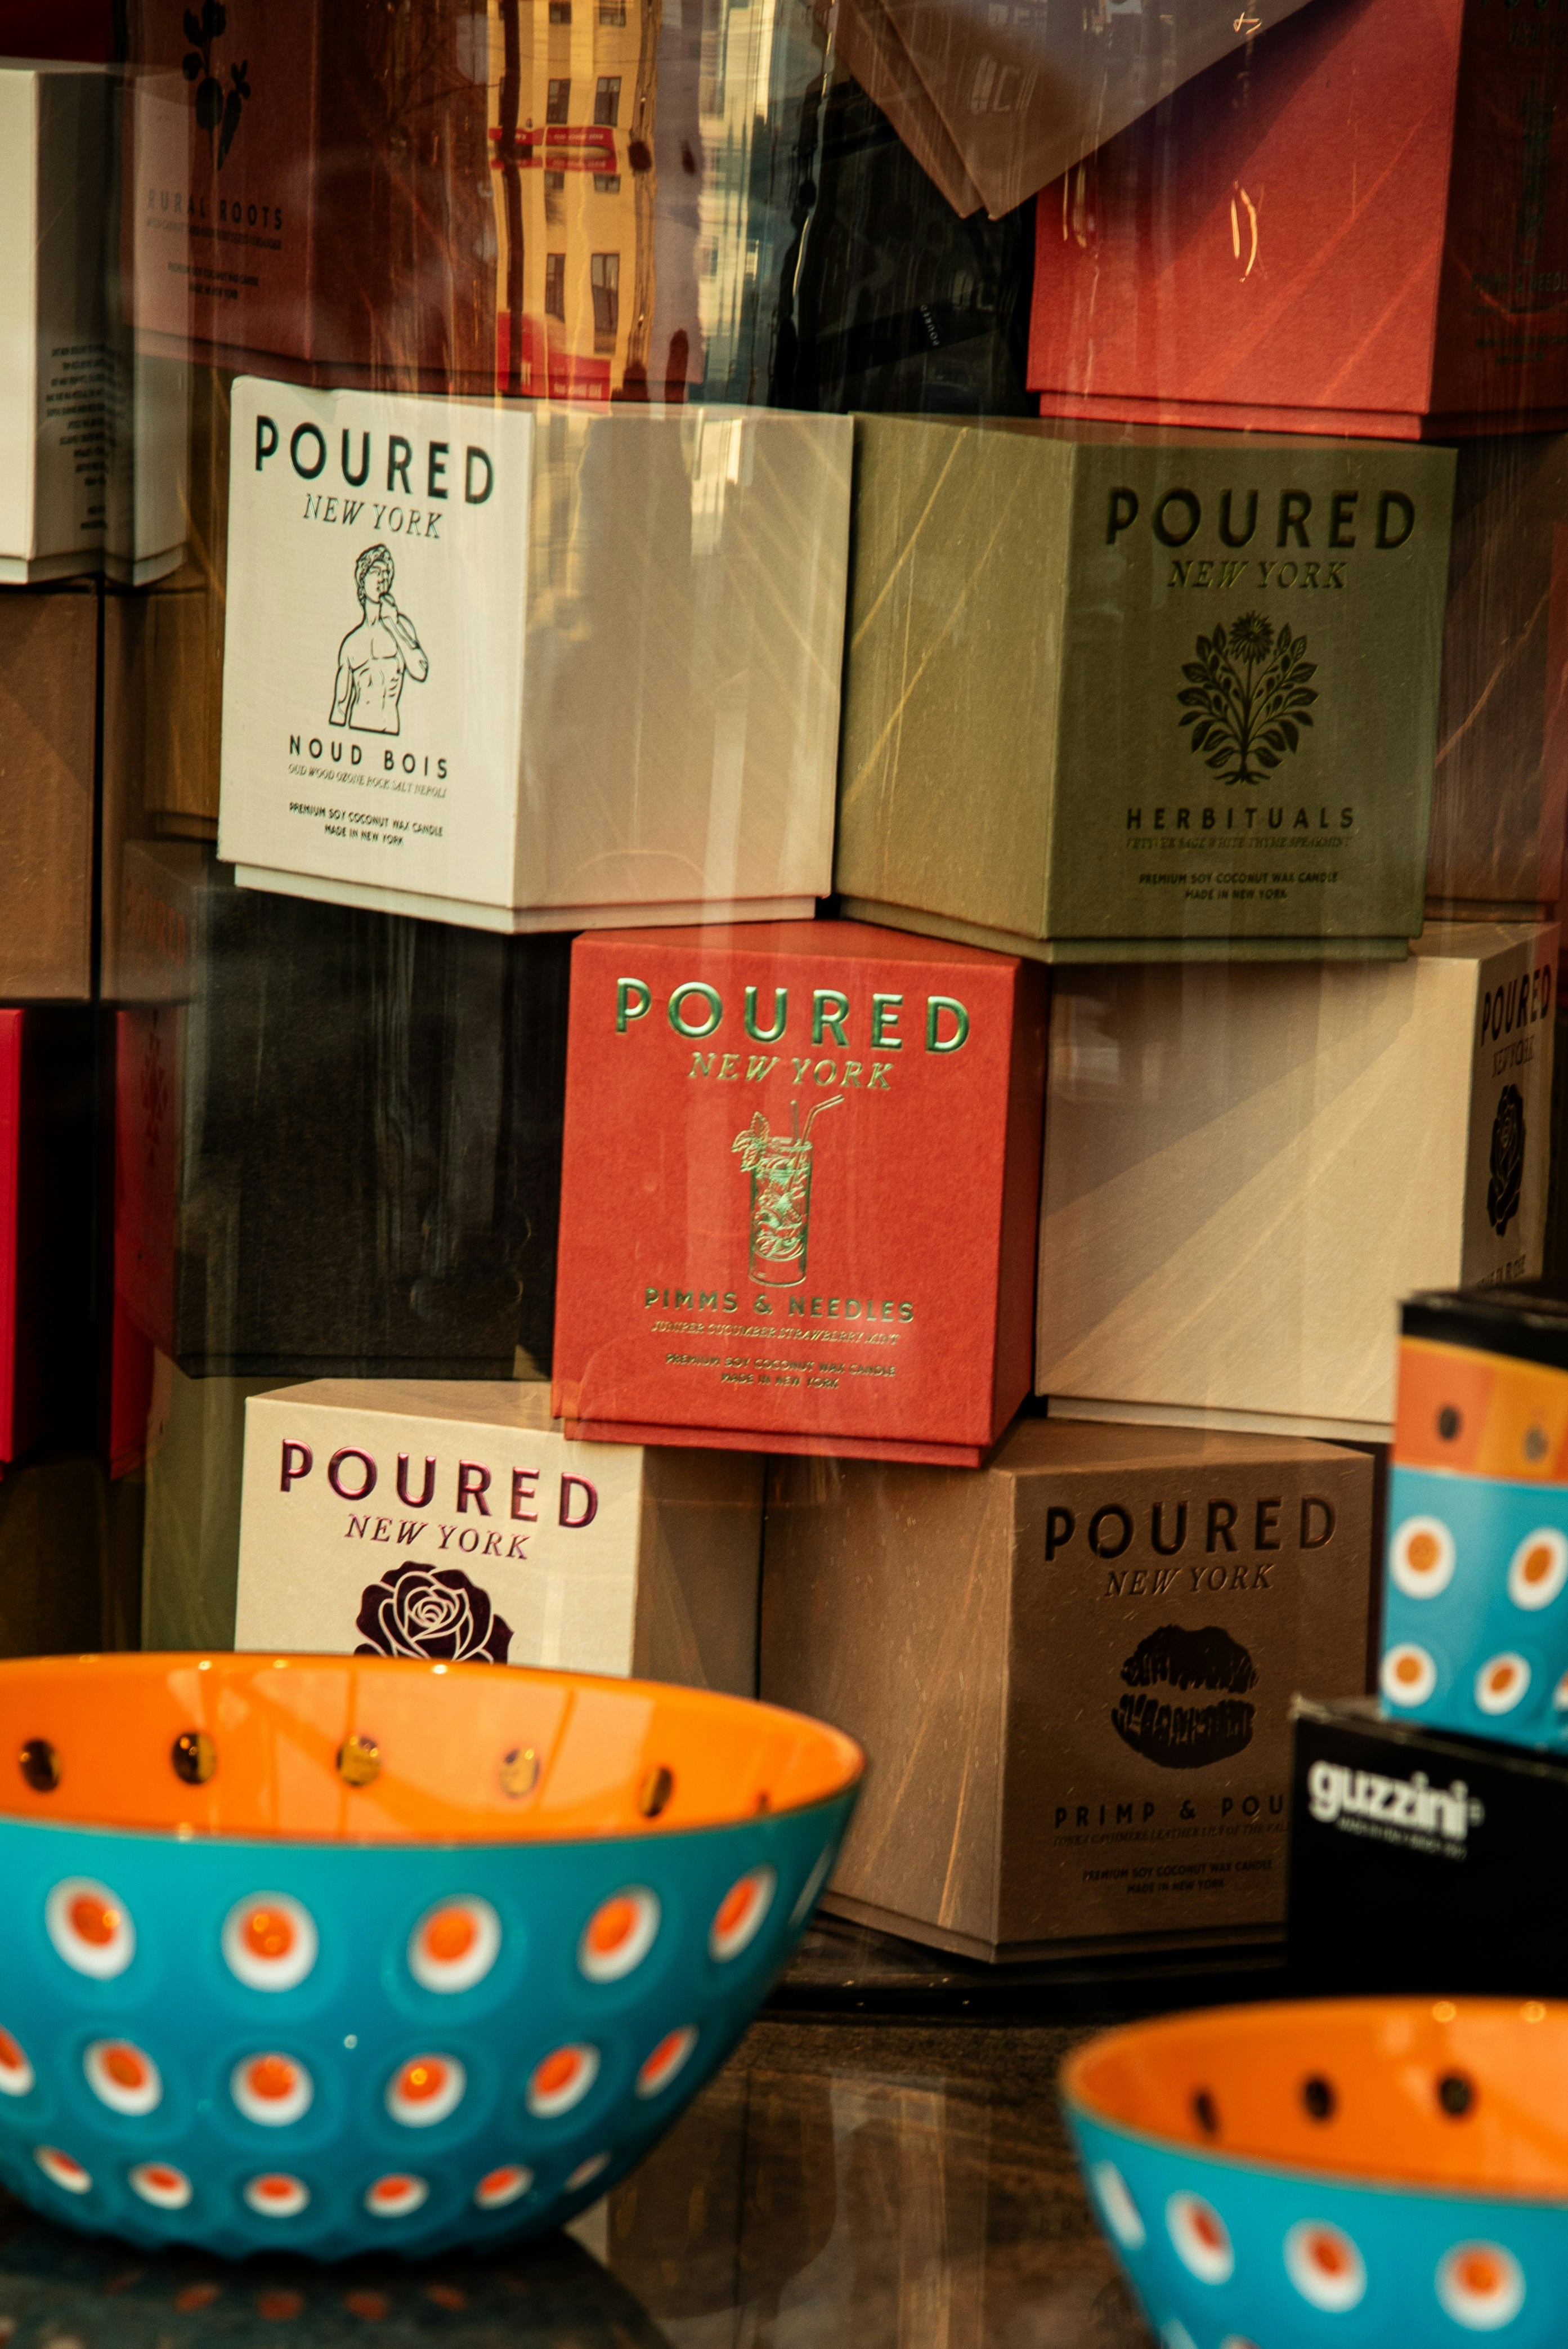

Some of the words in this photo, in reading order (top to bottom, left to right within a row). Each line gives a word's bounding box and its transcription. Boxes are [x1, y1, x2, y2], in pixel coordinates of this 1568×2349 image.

[148, 188, 206, 218] RURAL
[220, 199, 283, 230] ROOTS
[920, 305, 940, 346] POURED
[255, 414, 495, 504] POURED
[303, 492, 365, 526] NEW
[373, 503, 442, 539] YORK
[1105, 486, 1415, 549] POURED
[1167, 560, 1249, 589] NEW
[1256, 561, 1347, 589] YORK
[289, 734, 362, 766] NOUD
[383, 749, 448, 779] BOIS
[288, 763, 306, 775] OUD
[308, 767, 335, 780] WOOD
[336, 771, 365, 786] OZONE
[366, 776, 390, 789] ROCK
[392, 780, 413, 793] SALT
[414, 784, 447, 798] NEROLI
[289, 802, 326, 817] PREMIUM
[329, 808, 346, 821] SOY
[348, 811, 389, 827] COCONUT
[393, 819, 410, 831] WAX
[412, 822, 443, 837] CANDLE
[324, 824, 347, 837] MADE
[349, 829, 359, 838] IN
[361, 830, 379, 842] NEW
[383, 834, 404, 846] YORK
[1126, 807, 1355, 830] HERBITUALS
[1139, 873, 1186, 885] PREMIUM
[1190, 873, 1212, 884] SOY
[1216, 873, 1268, 884] COCONUT
[1271, 872, 1295, 883] WAX
[1297, 871, 1338, 883] CANDLE
[1185, 889, 1213, 900] MADE
[1217, 889, 1229, 900] IN
[1231, 889, 1255, 900] NEW
[1258, 889, 1288, 899] YORK
[615, 977, 970, 1054] POURED
[1480, 964, 1551, 1048] POURED
[687, 1051, 779, 1081] NEW
[790, 1057, 894, 1090] YORK
[644, 1287, 738, 1313] PIMMS
[753, 1293, 774, 1316] &
[788, 1296, 915, 1324] NEEDLES
[707, 1323, 776, 1339] CUCUMBER
[778, 1327, 863, 1344] STRAWBERRY
[666, 1354, 720, 1367] PREMIUM
[724, 1357, 751, 1368] SOY
[754, 1358, 816, 1372] COCONUT
[819, 1363, 846, 1374] WAX
[849, 1364, 896, 1377] CANDLE
[721, 1373, 754, 1384] MADE
[758, 1374, 770, 1385] IN
[775, 1375, 802, 1386] NEW
[807, 1377, 839, 1389] YORK
[280, 1438, 599, 1529] POURED
[344, 1513, 428, 1545] NEW
[437, 1523, 531, 1560] YORK
[1045, 1493, 1336, 1561] POURED
[1097, 1568, 1181, 1600] NEW
[1189, 1563, 1276, 1593] YORK
[1055, 1801, 1155, 1828] PRIMP
[1179, 1798, 1196, 1820] &
[1307, 1761, 1468, 1842] guzzini
[1150, 1827, 1199, 1841] LEATHER
[1083, 1868, 1128, 1881] PREMIUM
[1132, 1867, 1153, 1878] SOY
[1156, 1863, 1206, 1877] COCONUT
[1209, 1862, 1231, 1873] WAX
[1234, 1859, 1273, 1872] CANDLE
[1127, 1882, 1155, 1894] MADE
[1158, 1881, 1170, 1891] IN
[1172, 1880, 1195, 1891] NEW
[1198, 1878, 1224, 1890] YORK
